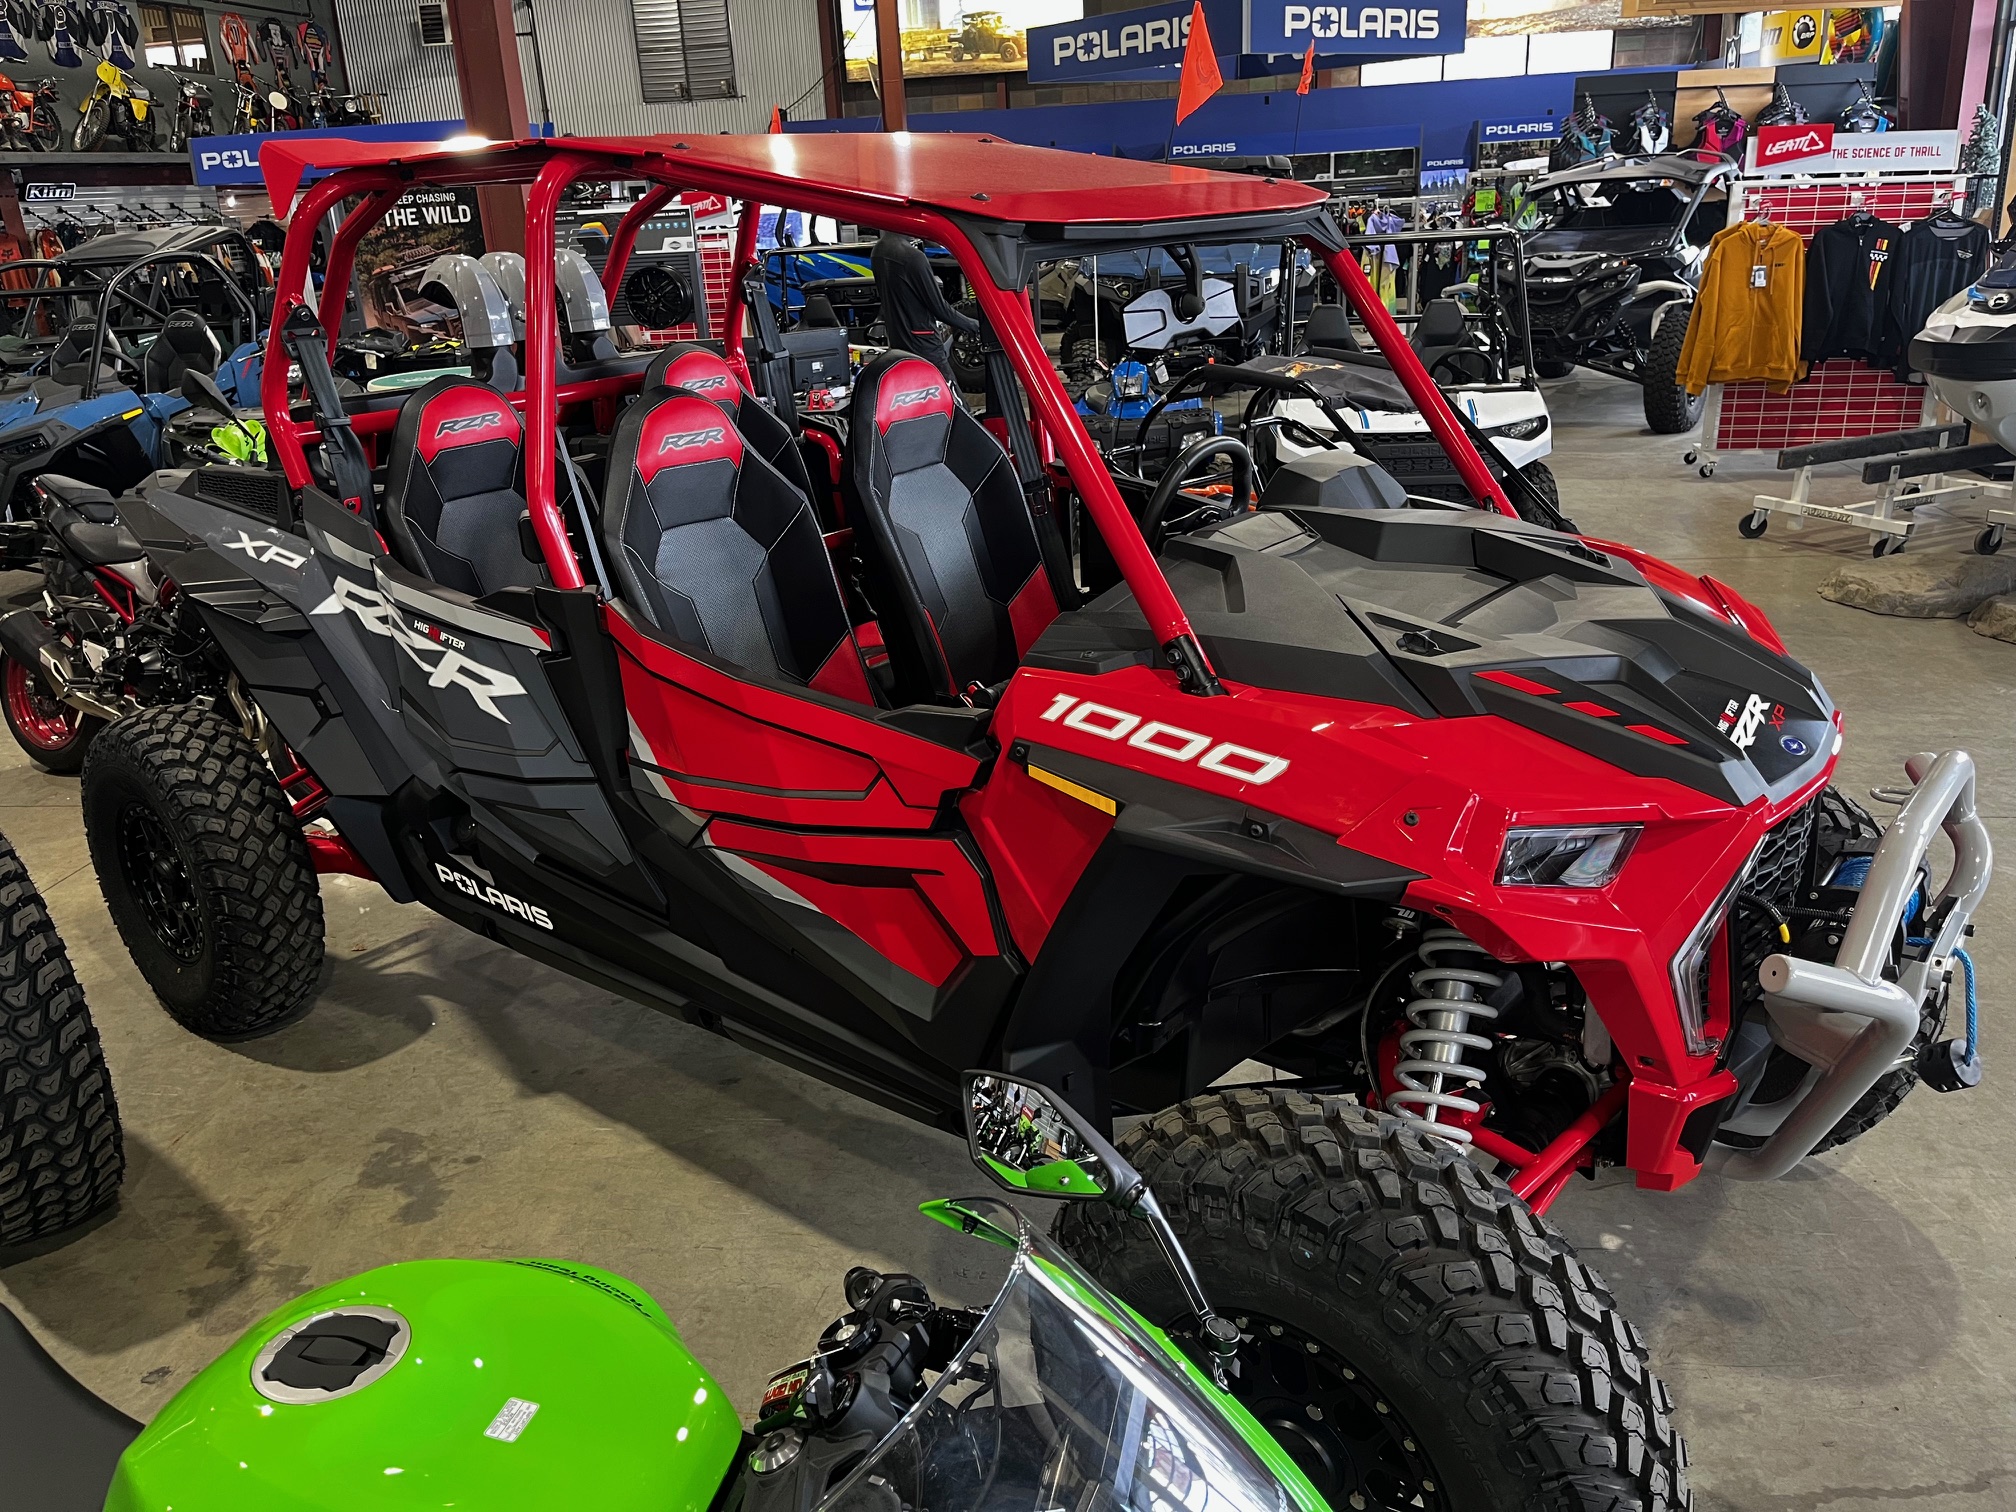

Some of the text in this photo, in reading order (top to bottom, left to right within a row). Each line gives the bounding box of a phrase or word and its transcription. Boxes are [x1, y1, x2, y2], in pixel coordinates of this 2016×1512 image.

[1285, 5, 1440, 39] POLARIS
[1485, 122, 1554, 136] POLARIS
[1172, 142, 1237, 155] POLARIS
[1426, 158, 1465, 167] POLARIS
[1831, 145, 1942, 159] THE SCIENCE OF THRILL
[415, 191, 457, 205] CHASING
[384, 204, 473, 228] THE WILD
[168, 320, 195, 329] RZR
[681, 375, 727, 392] RZR
[889, 385, 942, 412] RZR
[434, 410, 502, 440] RZR
[657, 426, 726, 456] RZR
[222, 529, 308, 570] XP
[309, 575, 528, 725] RZR
[1729, 693, 1771, 751] RZR
[1768, 703, 1786, 732] XP
[1039, 692, 1291, 786] 1000
[434, 862, 554, 931] POLARIS
